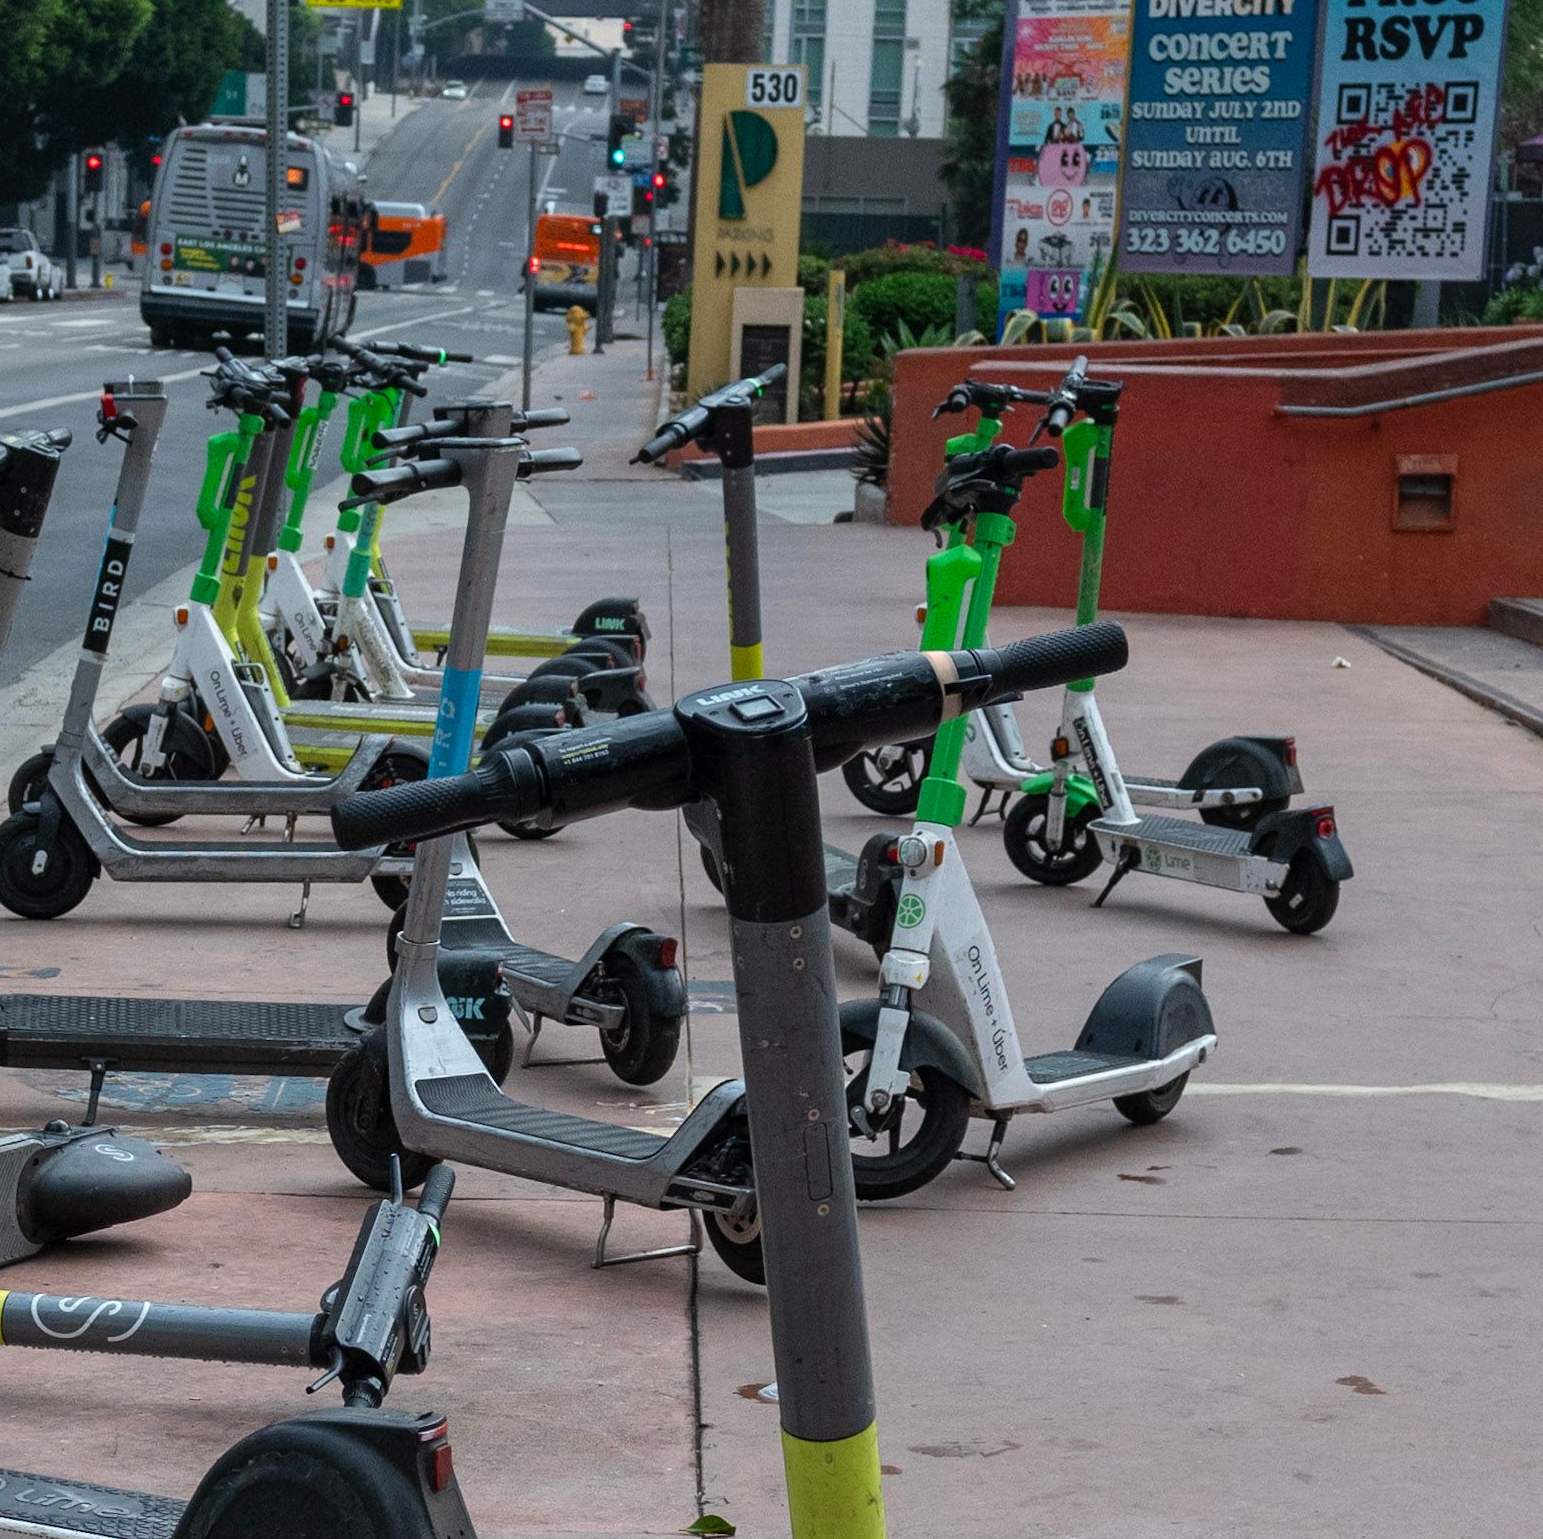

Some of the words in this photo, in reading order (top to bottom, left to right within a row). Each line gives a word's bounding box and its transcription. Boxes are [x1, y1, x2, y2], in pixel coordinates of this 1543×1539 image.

[1341, 14, 1484, 61] RSVP
[752, 73, 799, 104] 530
[1209, 100, 1258, 119] JULY
[1256, 151, 1293, 168] 6TH
[1126, 228, 1170, 253] 323
[1175, 229, 1220, 254] 362
[1226, 229, 1287, 255] 6450
[93, 560, 124, 632] BIRD
[295, 613, 307, 631] On
[303, 629, 317, 651] Lime
[595, 617, 626, 630] LINK
[697, 685, 766, 706] LINK
[210, 670, 221, 690] On
[217, 689, 231, 718] Lime
[231, 727, 248, 755] Uber
[451, 896, 487, 906] sidewalks
[457, 888, 477, 898] riding
[968, 945, 982, 974] On
[977, 973, 994, 1016] Lime
[15, 1488, 132, 1519] Lime
